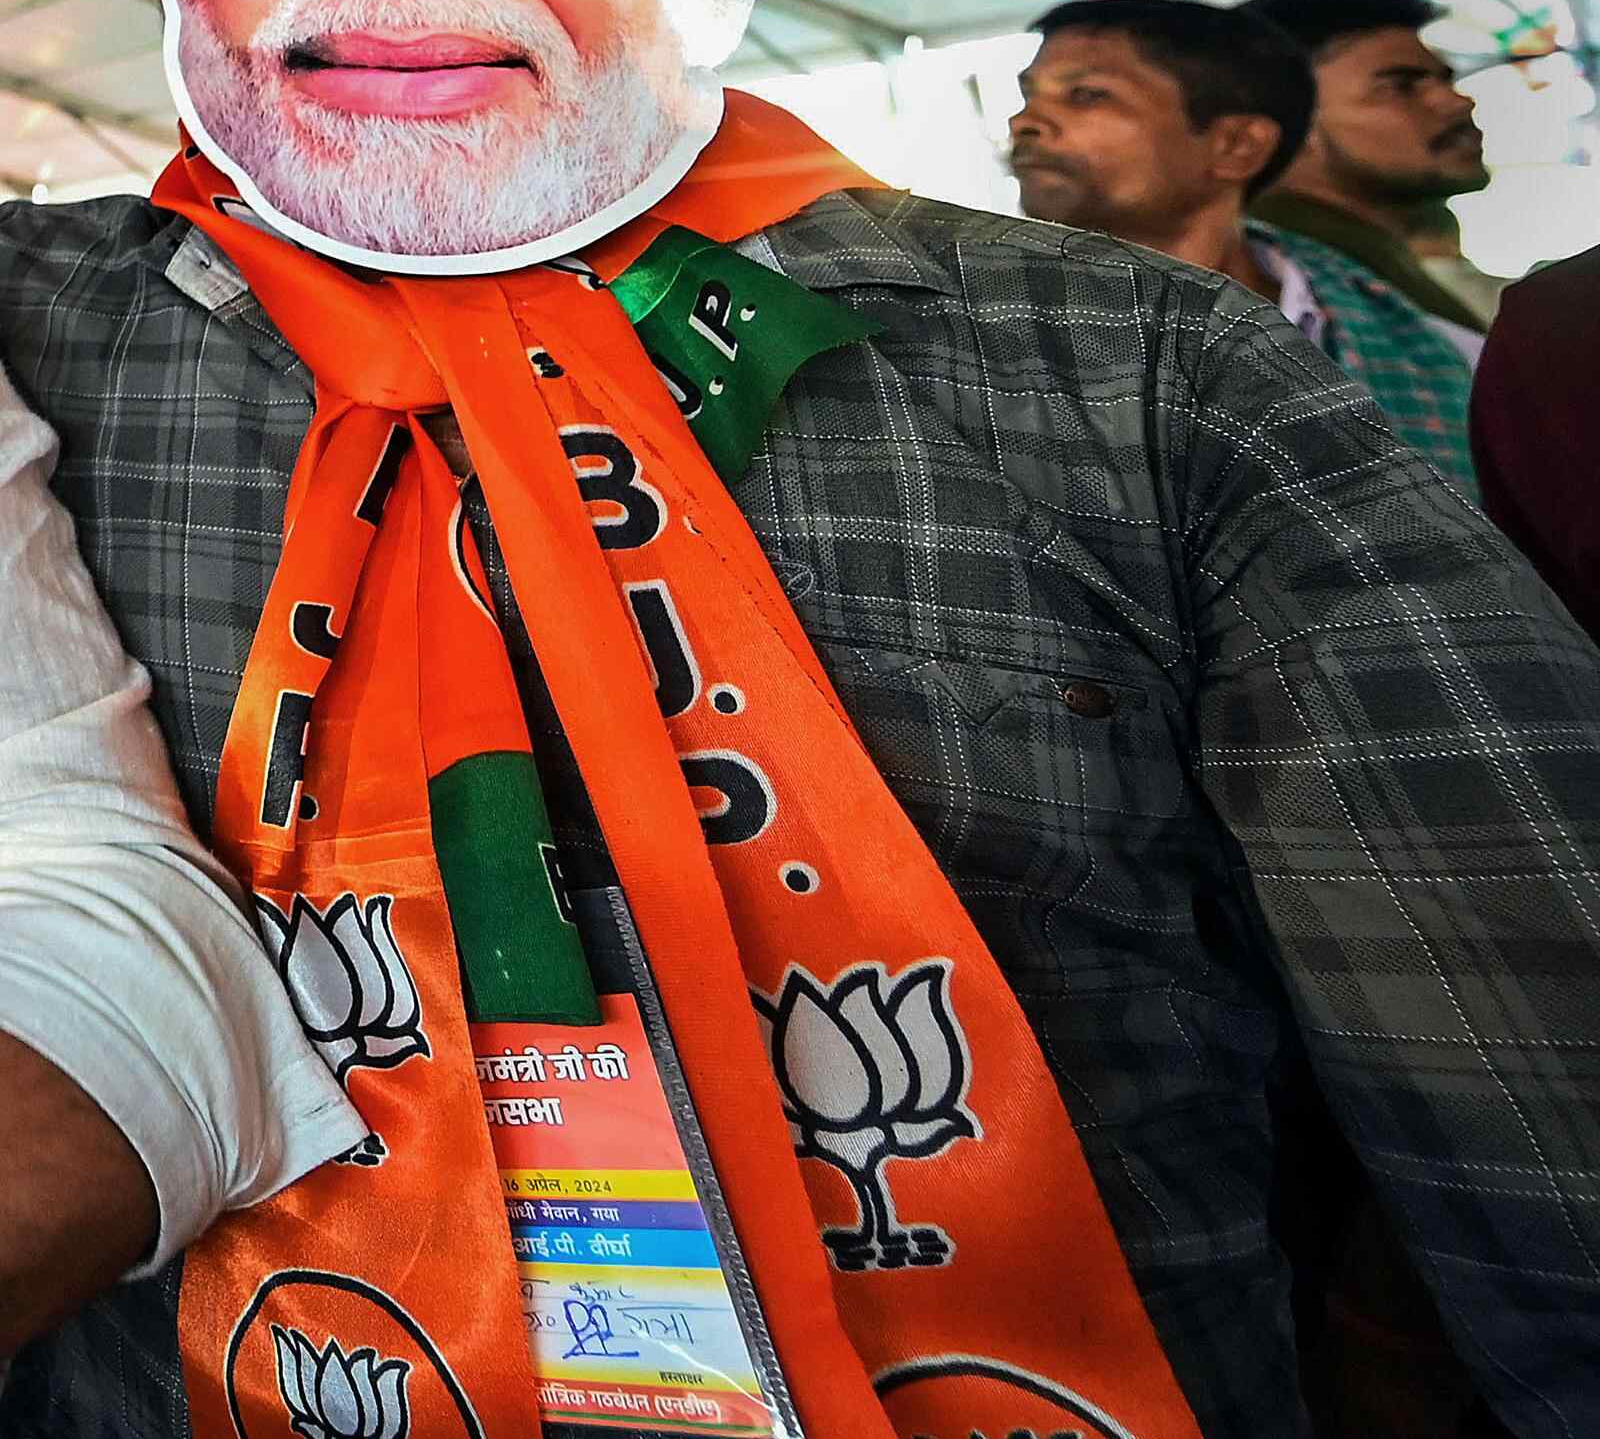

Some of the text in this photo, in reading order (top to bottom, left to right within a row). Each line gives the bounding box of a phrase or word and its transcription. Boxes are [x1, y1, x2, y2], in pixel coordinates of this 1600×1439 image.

[547, 1045, 586, 1081] जी
[587, 1043, 629, 1080] की
[574, 1180, 612, 1193] 2024
[590, 1206, 620, 1221] गया
